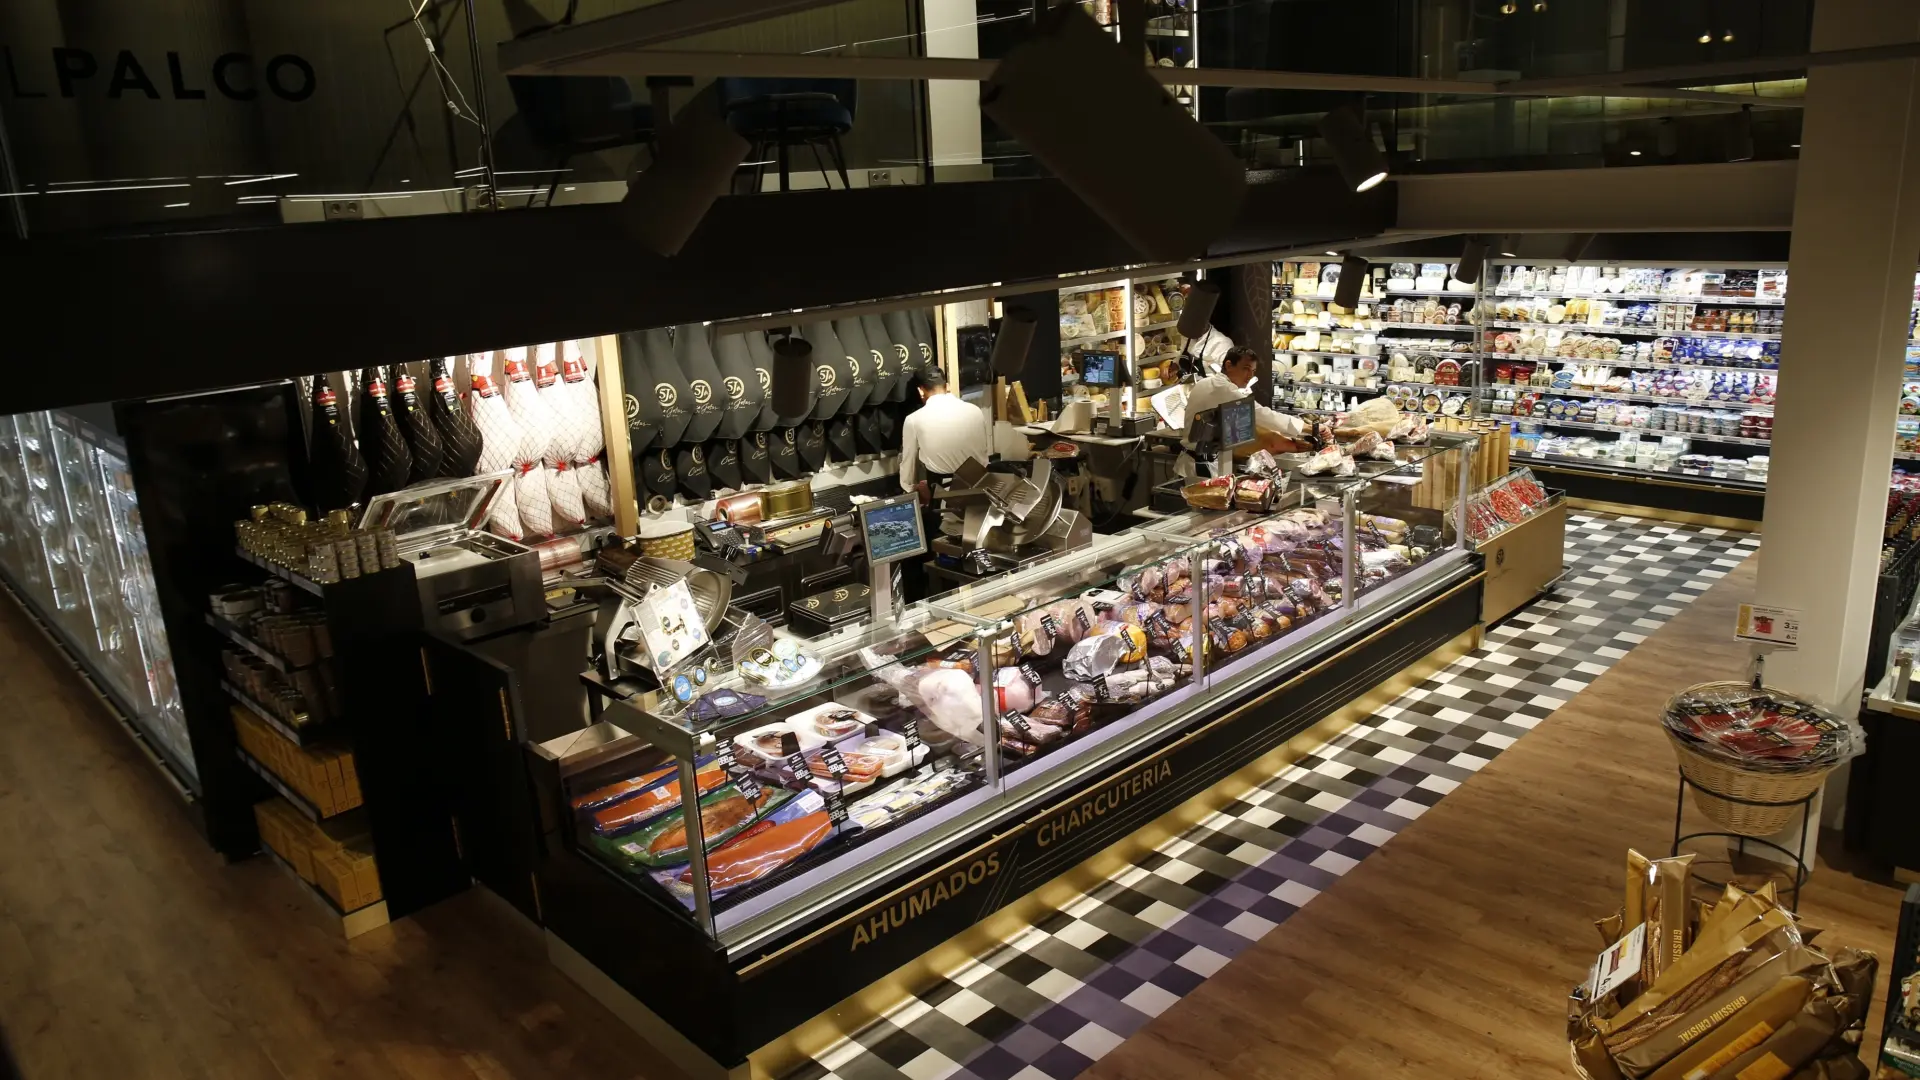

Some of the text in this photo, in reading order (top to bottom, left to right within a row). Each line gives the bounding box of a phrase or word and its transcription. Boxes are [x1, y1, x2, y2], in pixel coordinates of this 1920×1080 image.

[53, 47, 316, 102] PALCO
[850, 852, 1000, 950] AHUMADOS
[1677, 995, 1748, 1043] GRISSINI CRISTAL
